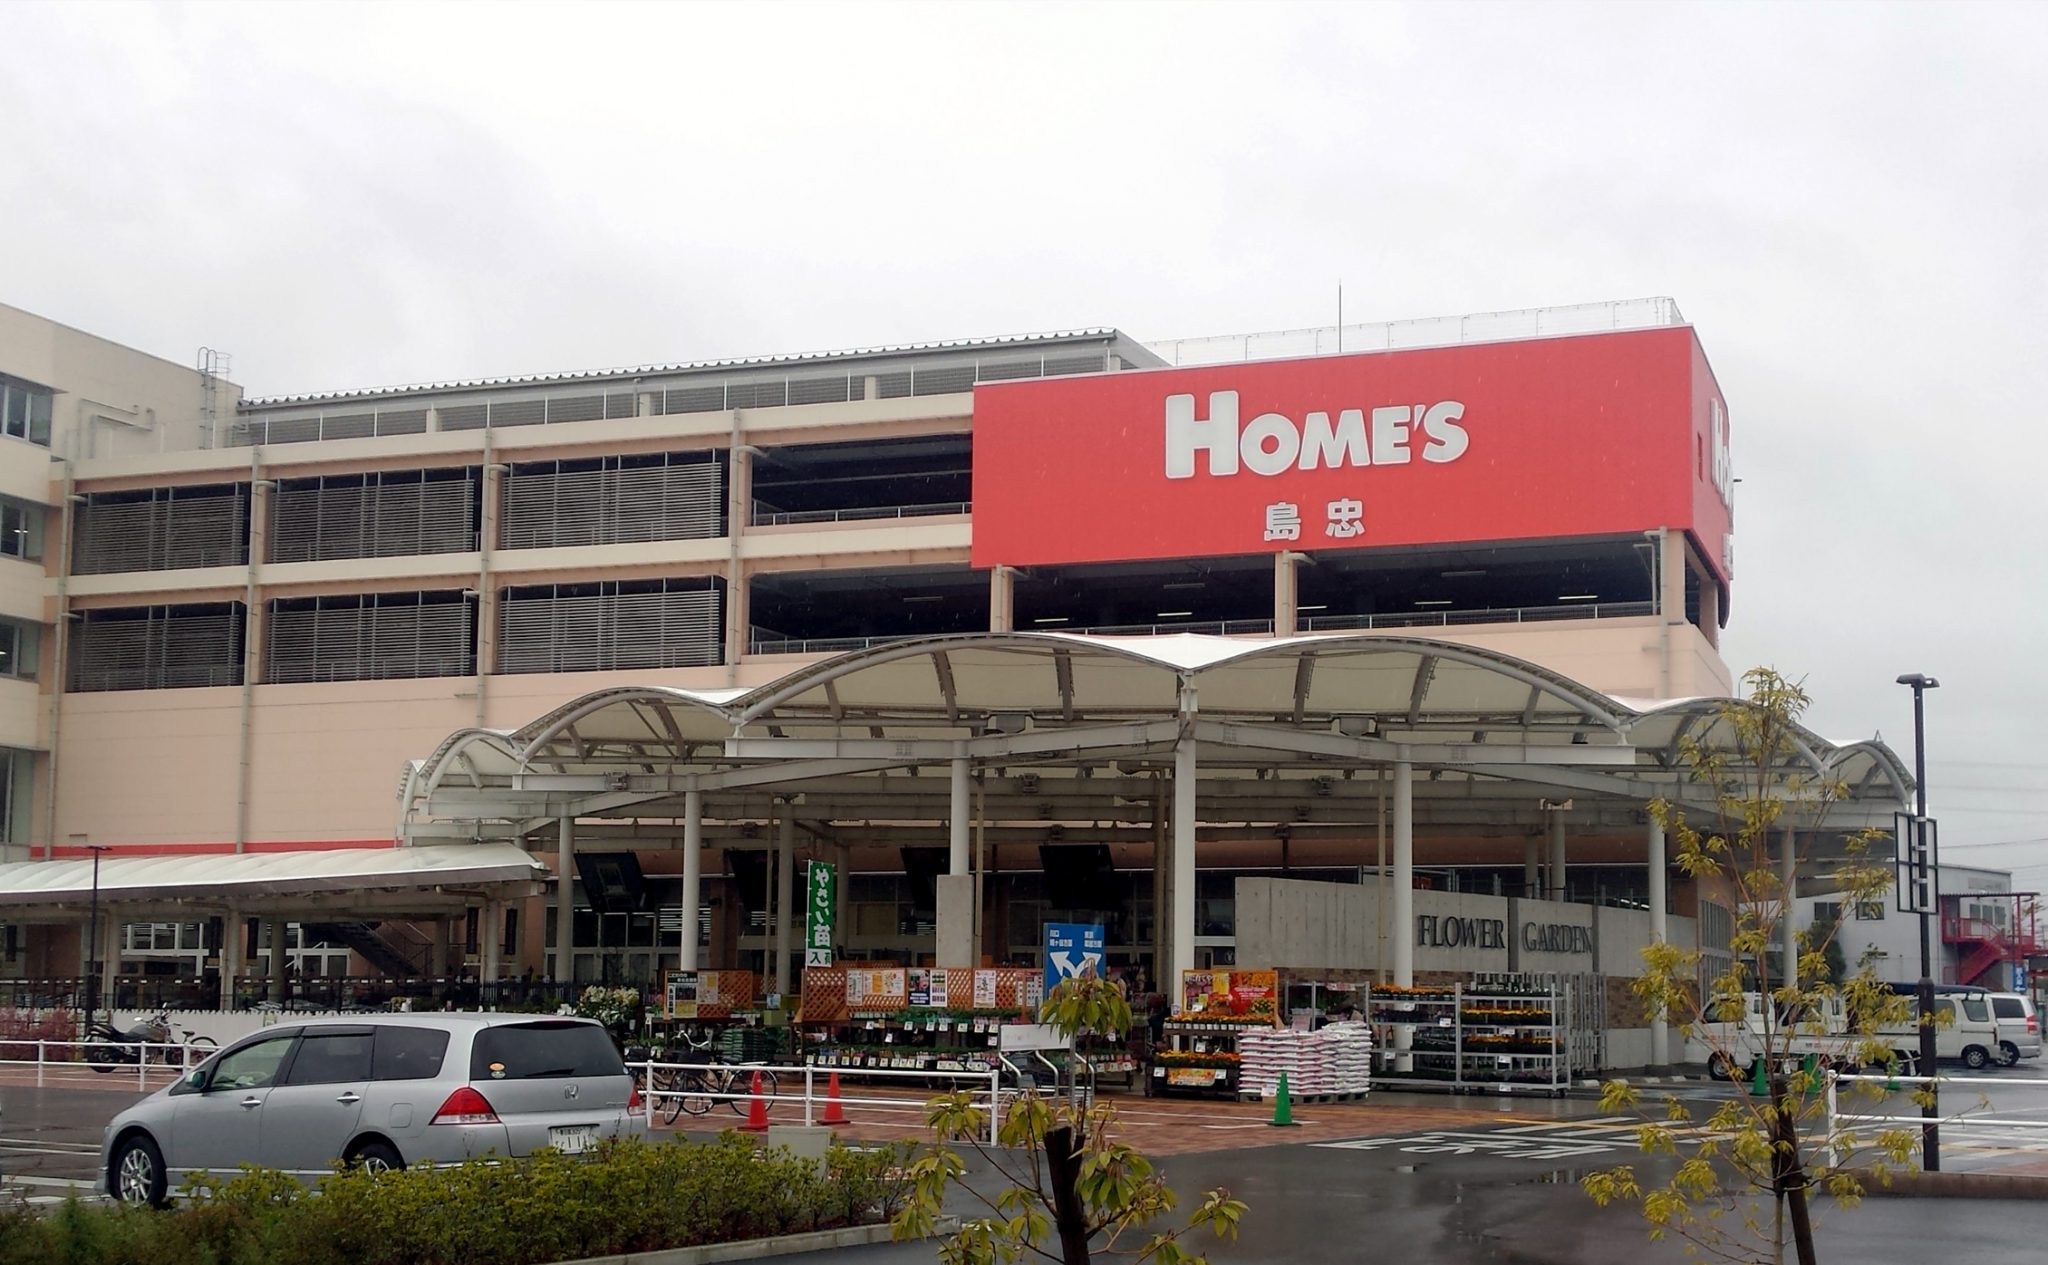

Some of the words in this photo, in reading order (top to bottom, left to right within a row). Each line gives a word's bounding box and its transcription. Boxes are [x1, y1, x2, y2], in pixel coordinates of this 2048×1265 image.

[1165, 390, 1470, 479] HOME'S
[1263, 498, 1366, 542] 島忠
[1418, 914, 1506, 949] FLOWER
[1522, 921, 1593, 953] GARDEN
